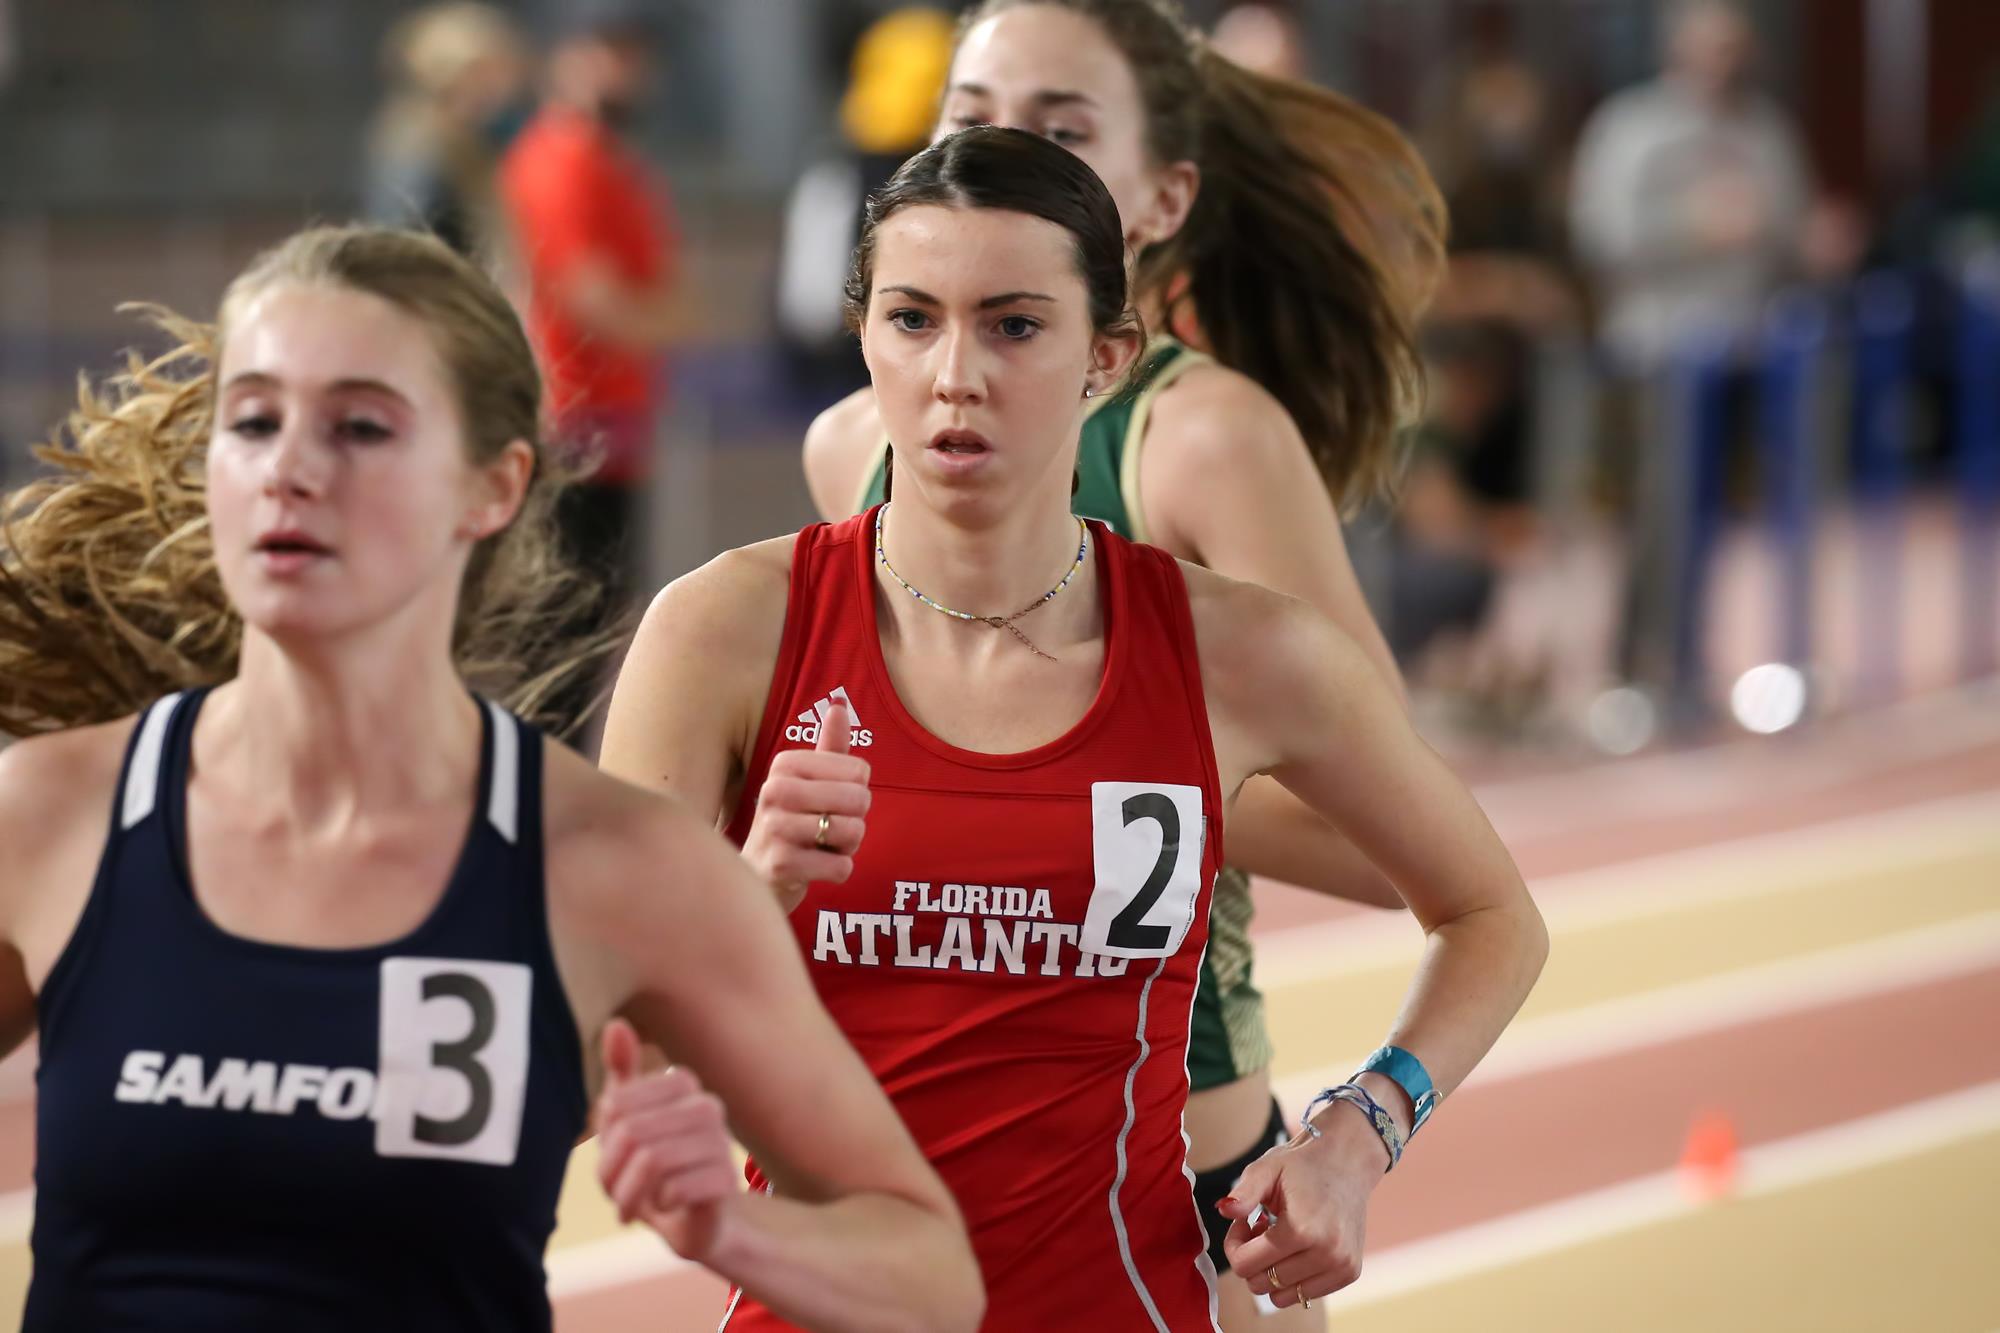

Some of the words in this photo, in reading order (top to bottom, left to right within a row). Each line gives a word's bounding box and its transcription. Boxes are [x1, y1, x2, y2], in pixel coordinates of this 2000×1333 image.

[785, 722, 873, 747] adas
[893, 880, 1053, 919] FLORIDA
[1106, 792, 1181, 949] 2
[115, 1050, 381, 1121] SAMFO
[412, 972, 496, 1147] 3
